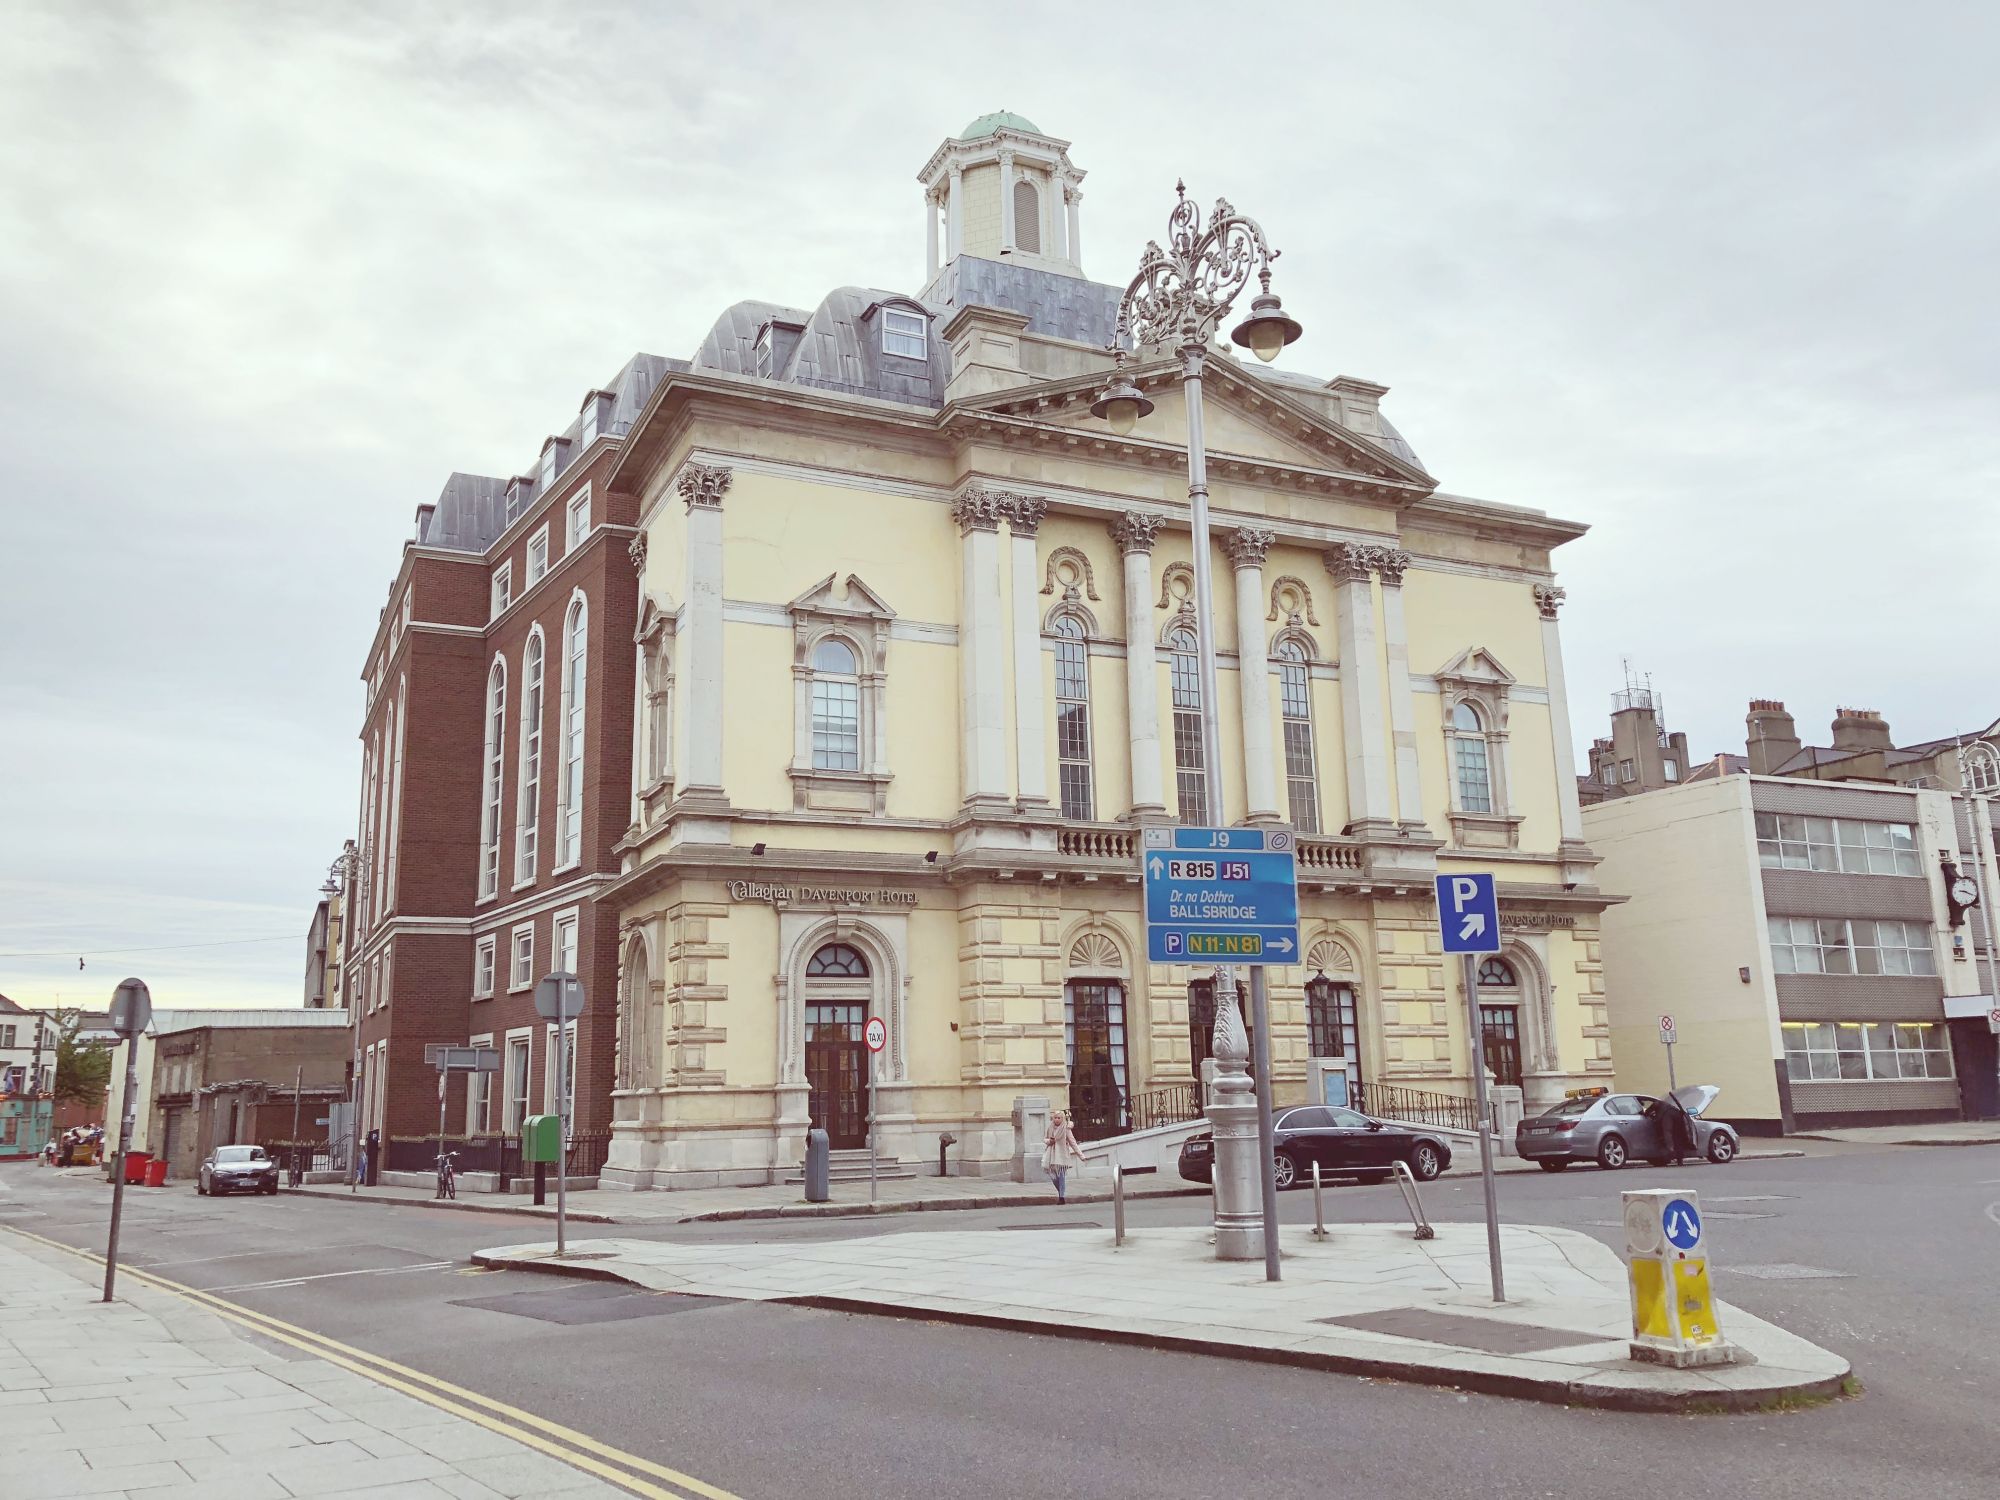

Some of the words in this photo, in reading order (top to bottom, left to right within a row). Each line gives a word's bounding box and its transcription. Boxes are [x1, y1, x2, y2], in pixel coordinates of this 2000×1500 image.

[1209, 831, 1230, 848] J9
[1170, 862, 1181, 877] R
[1186, 863, 1215, 878] 815
[1223, 864, 1249, 879] J51
[801, 887, 876, 902] DAVENPORT
[880, 889, 920, 903] HOTEL
[1170, 890, 1182, 902] Dr.
[1185, 892, 1198, 902] na
[1200, 890, 1234, 903] Dothra
[1452, 878, 1478, 913] P
[1169, 905, 1257, 919] BALLSBRIDGE
[1168, 936, 1180, 951] P
[868, 1032, 883, 1042] TAXI
